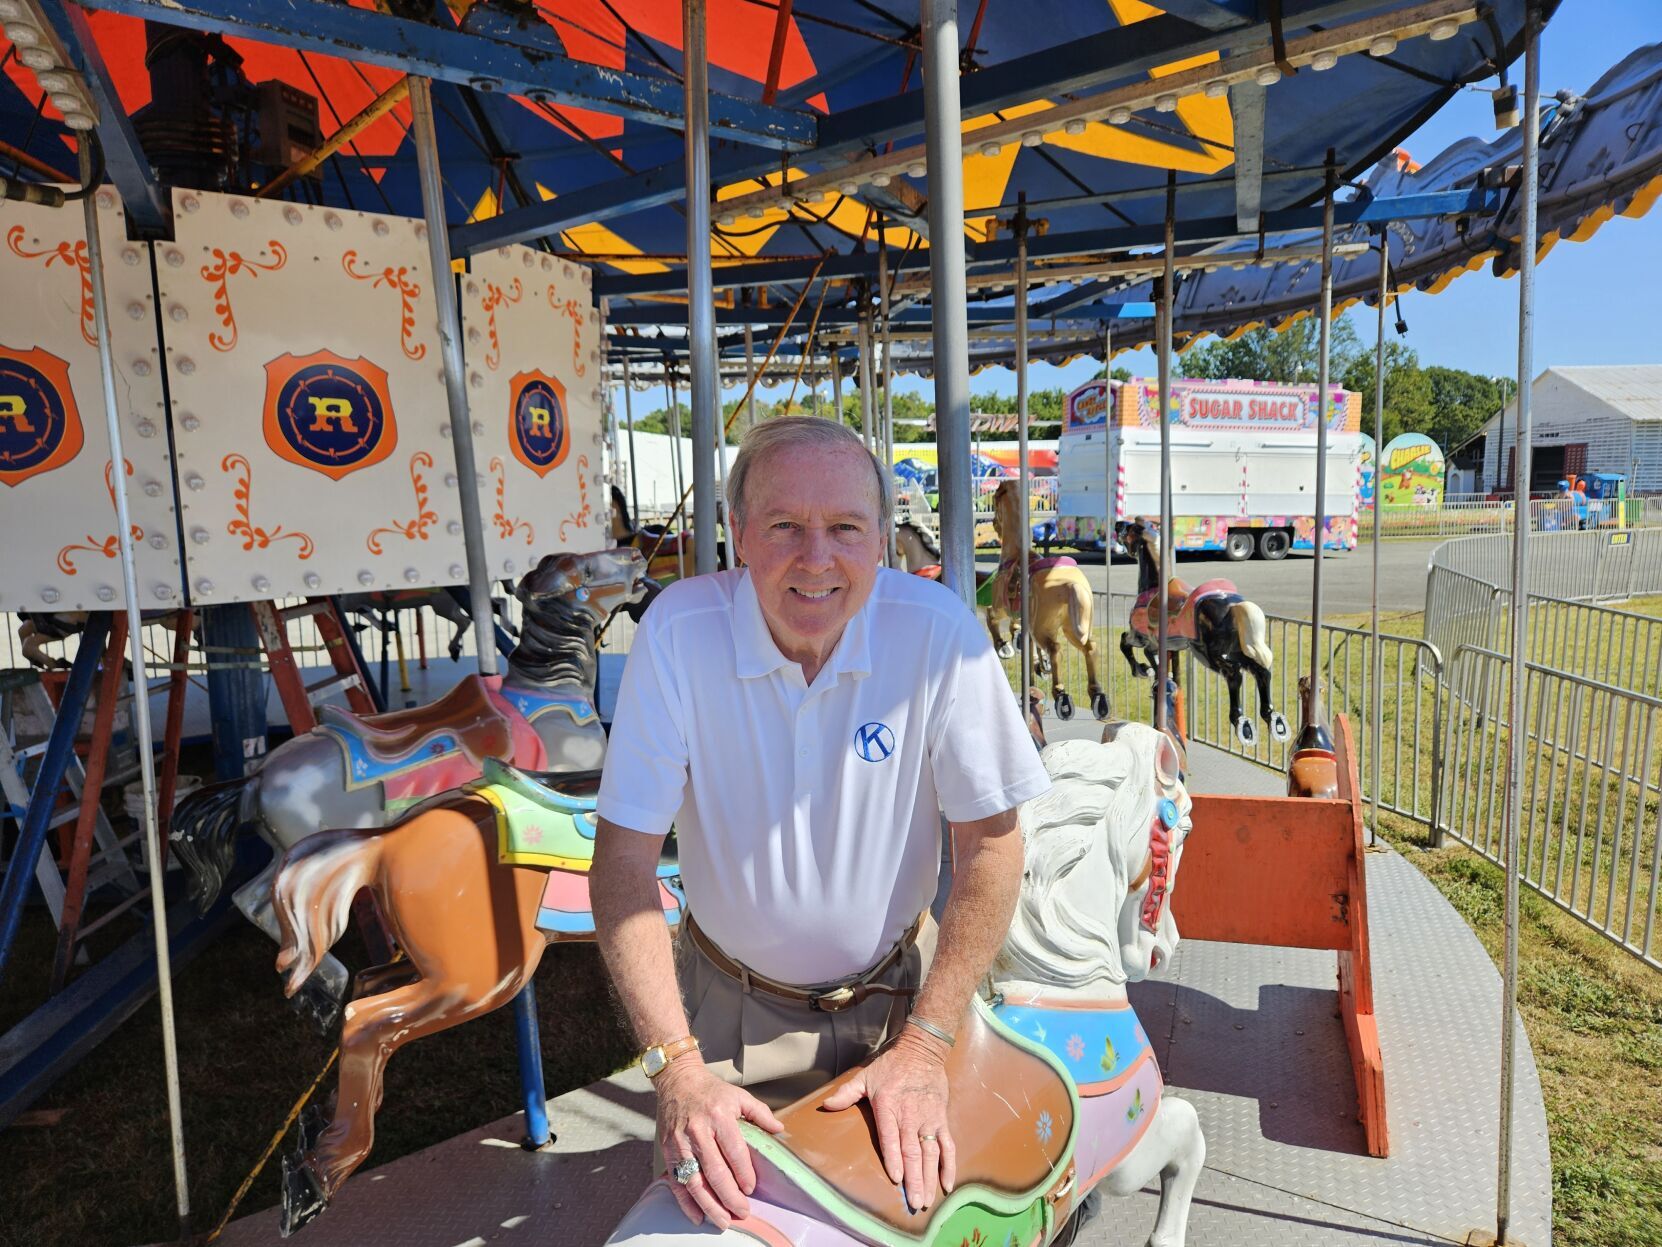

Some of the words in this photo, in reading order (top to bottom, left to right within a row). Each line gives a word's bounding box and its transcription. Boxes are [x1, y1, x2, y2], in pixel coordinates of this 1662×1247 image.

[308, 396, 358, 432] R
[529, 406, 552, 438] R
[1189, 398, 1243, 420] SUGAR
[1248, 399, 1299, 421] SHACK
[859, 723, 891, 761] K
